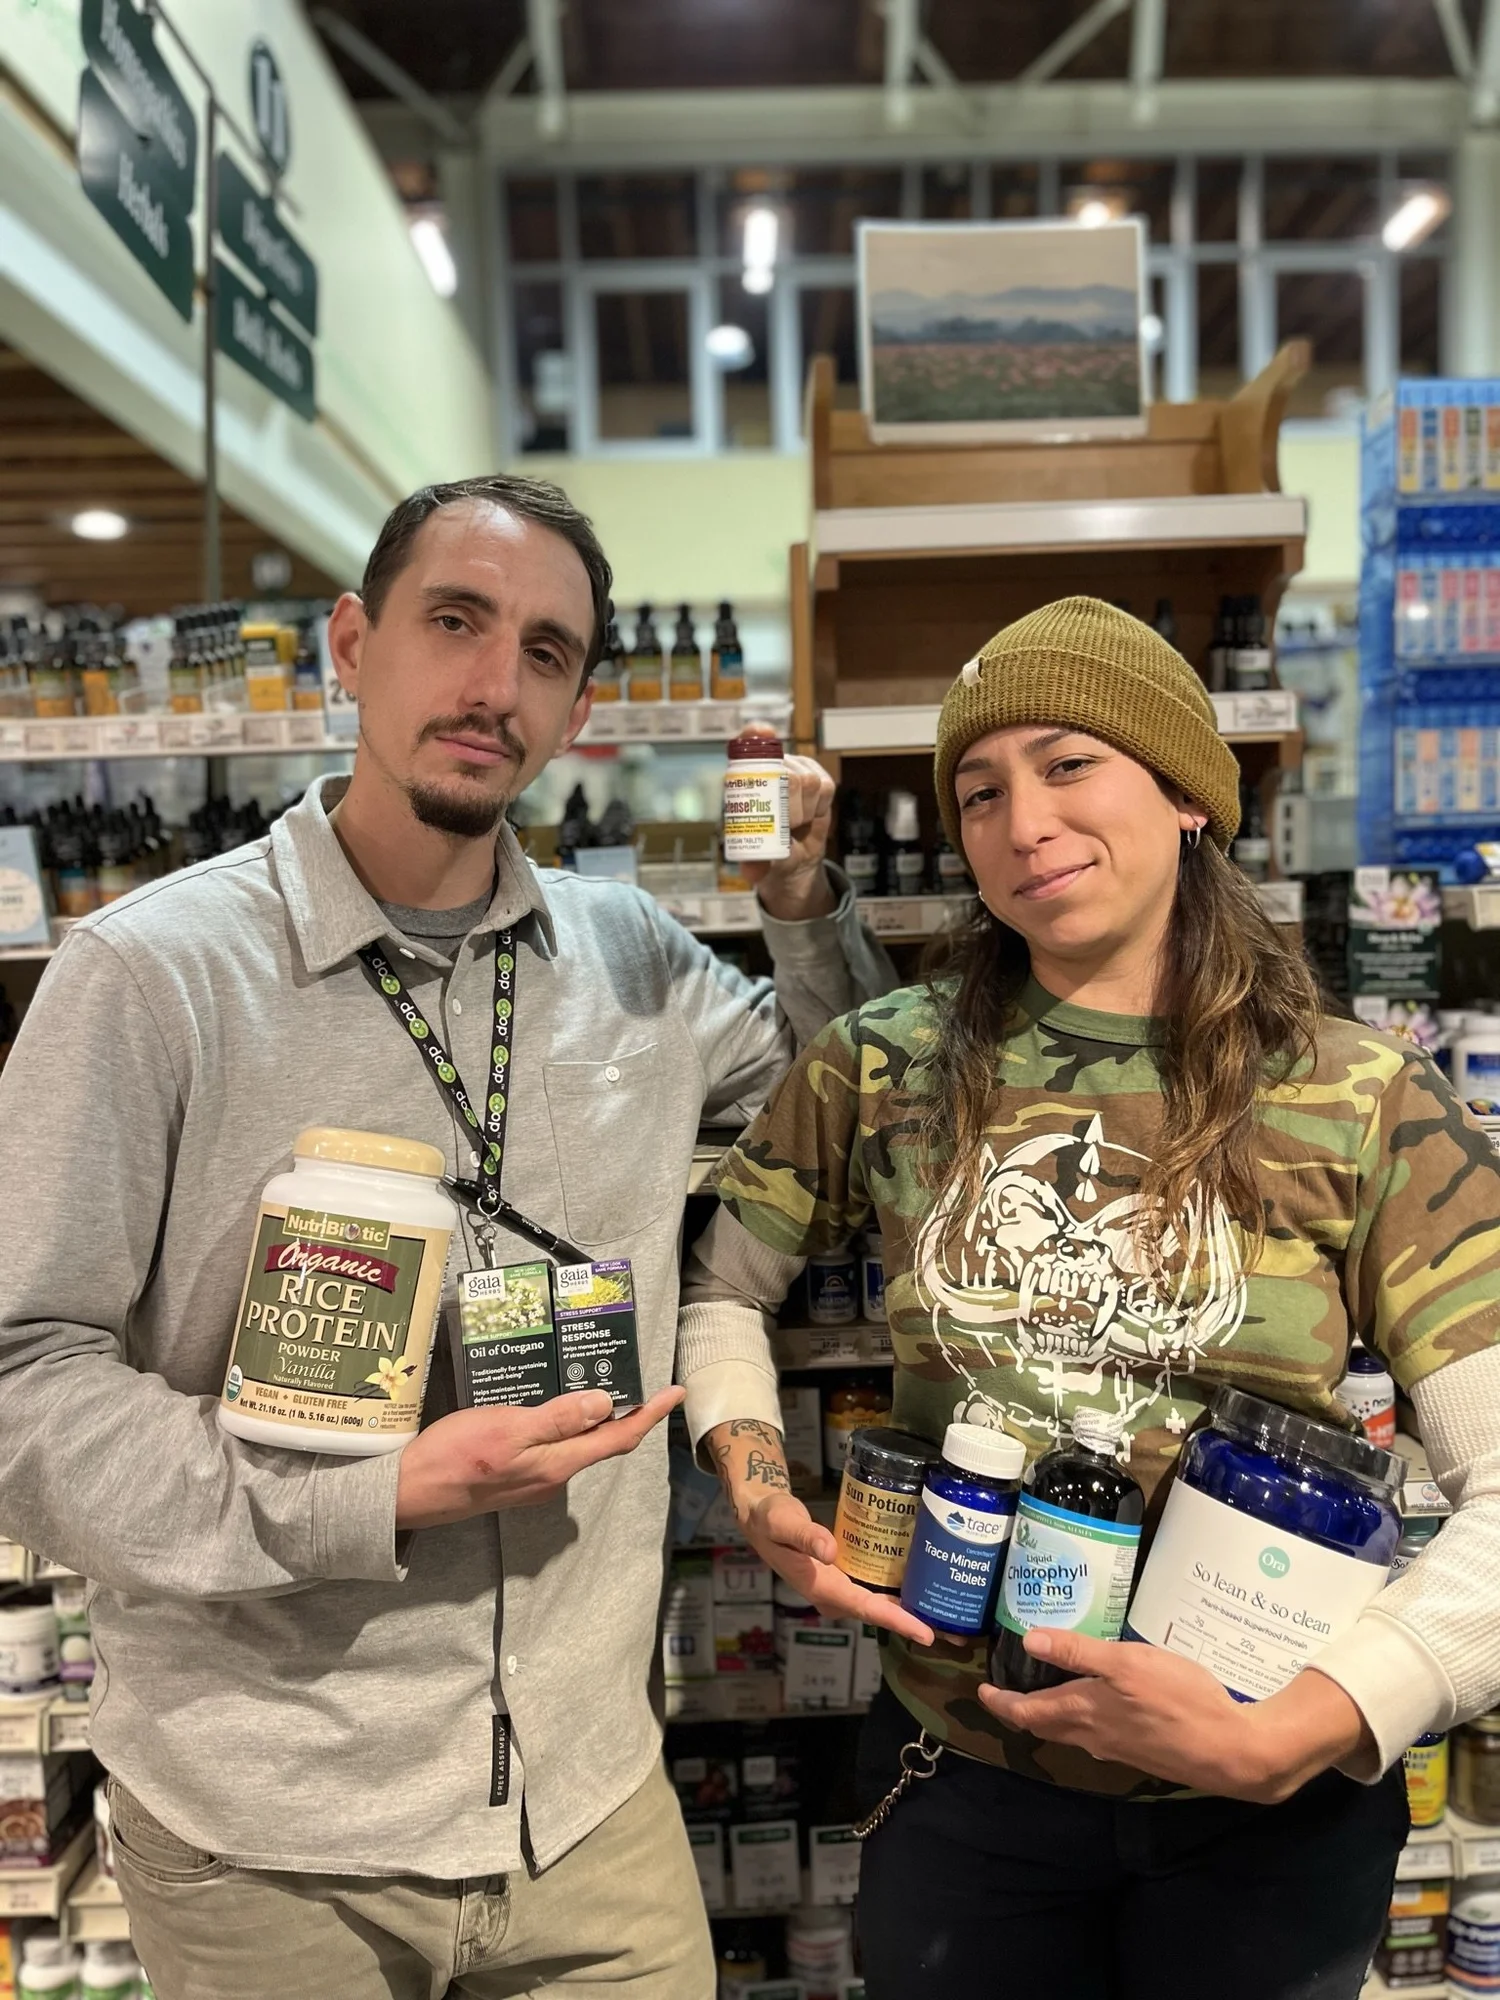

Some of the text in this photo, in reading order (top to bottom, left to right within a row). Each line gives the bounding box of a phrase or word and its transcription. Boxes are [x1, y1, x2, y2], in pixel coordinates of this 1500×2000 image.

[288, 1214, 386, 1243] NutriBiotic
[277, 1239, 382, 1283] Organic
[468, 1275, 502, 1298] gaia
[560, 1267, 589, 1288] gaia
[278, 1273, 368, 1315] RICE
[479, 1288, 501, 1296] HERBS
[245, 1300, 400, 1352] PROTEIN
[561, 1321, 596, 1334] STRESS
[561, 1328, 611, 1343] RESPONSE
[277, 1341, 341, 1362] POWDER
[469, 1341, 545, 1359] Oil of Oregano
[578, 1343, 598, 1351] manage
[609, 1338, 627, 1346] effects
[278, 1356, 336, 1381] Vanilla
[471, 1361, 548, 1377] Traditionally for sustaining
[273, 1373, 334, 1390] Naturally Flavored
[472, 1376, 492, 1384] overall
[473, 1382, 540, 1398] Helps maintain immune
[255, 1386, 279, 1400] VEGAN
[293, 1393, 325, 1408] GLUTEN
[327, 1398, 348, 1410] FREE
[473, 1394, 499, 1404] defenses
[508, 1392, 518, 1401] you
[531, 1388, 544, 1398] stay
[240, 1398, 248, 1408] Net
[258, 1402, 277, 1415] 21.16
[278, 1408, 287, 1417] oz.
[289, 1408, 297, 1419] (1
[298, 1409, 307, 1420] lb.
[308, 1411, 325, 1422] 5.16
[340, 1415, 364, 1428] (600g)
[846, 1482, 915, 1515] Sun Potion
[967, 1517, 999, 1535] trace
[842, 1529, 870, 1549] LION'S
[873, 1542, 905, 1557] MANE
[925, 1540, 990, 1572] Trace Mineral
[1027, 1554, 1052, 1563] Liquid
[1261, 1552, 1286, 1573] Ora
[949, 1567, 987, 1587] Tablets
[1008, 1563, 1088, 1582] Chlorophyll
[1018, 1583, 1073, 1599] 100 mg
[1192, 1561, 1331, 1635] So lean & so clean
[1018, 1607, 1037, 1615] Dietary
[1200, 1597, 1308, 1650] Plant-based Superfood Protein
[1240, 1638, 1256, 1653] 22g
[1213, 1663, 1274, 1694] DIETARY SUPPLEMENT
[498, 1726, 506, 1772] ASSEMBLY
